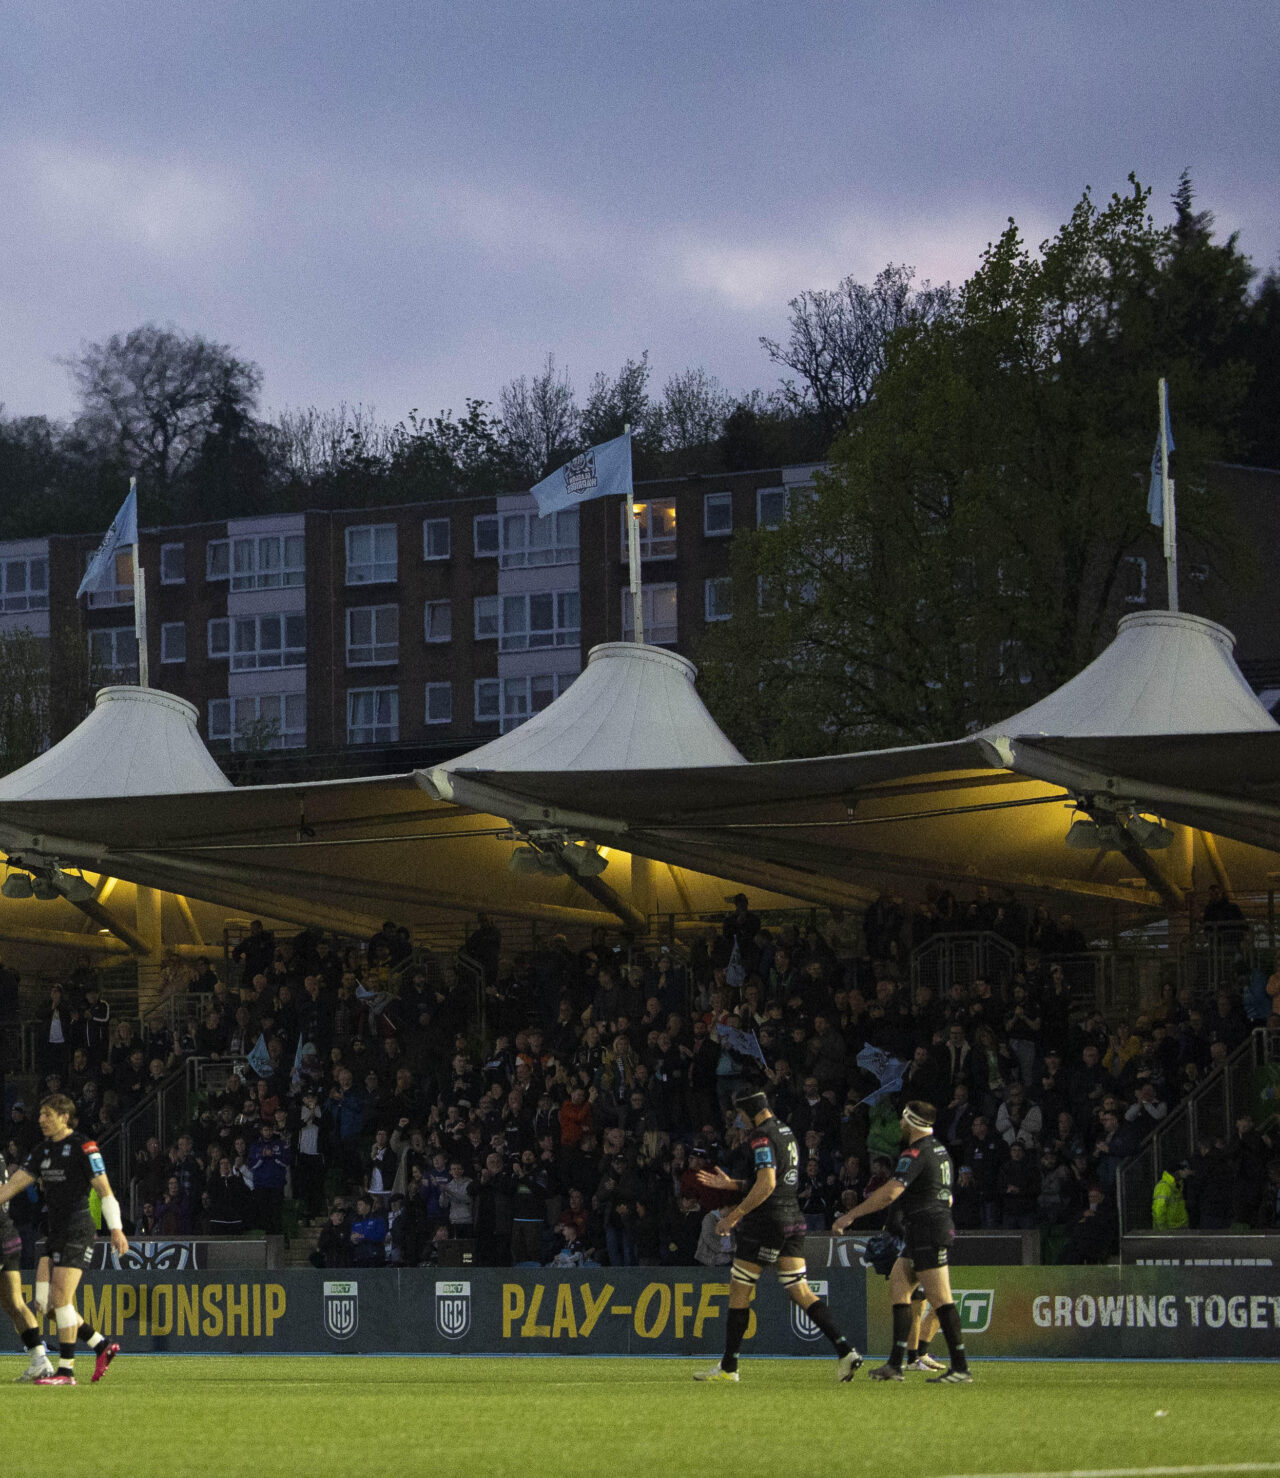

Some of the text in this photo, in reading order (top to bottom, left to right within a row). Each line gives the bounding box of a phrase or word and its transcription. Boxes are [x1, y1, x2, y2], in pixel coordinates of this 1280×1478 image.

[787, 1141, 799, 1167] 19
[939, 1160, 951, 1185] 18
[1032, 1294, 1280, 1329] GROWING TOGET
